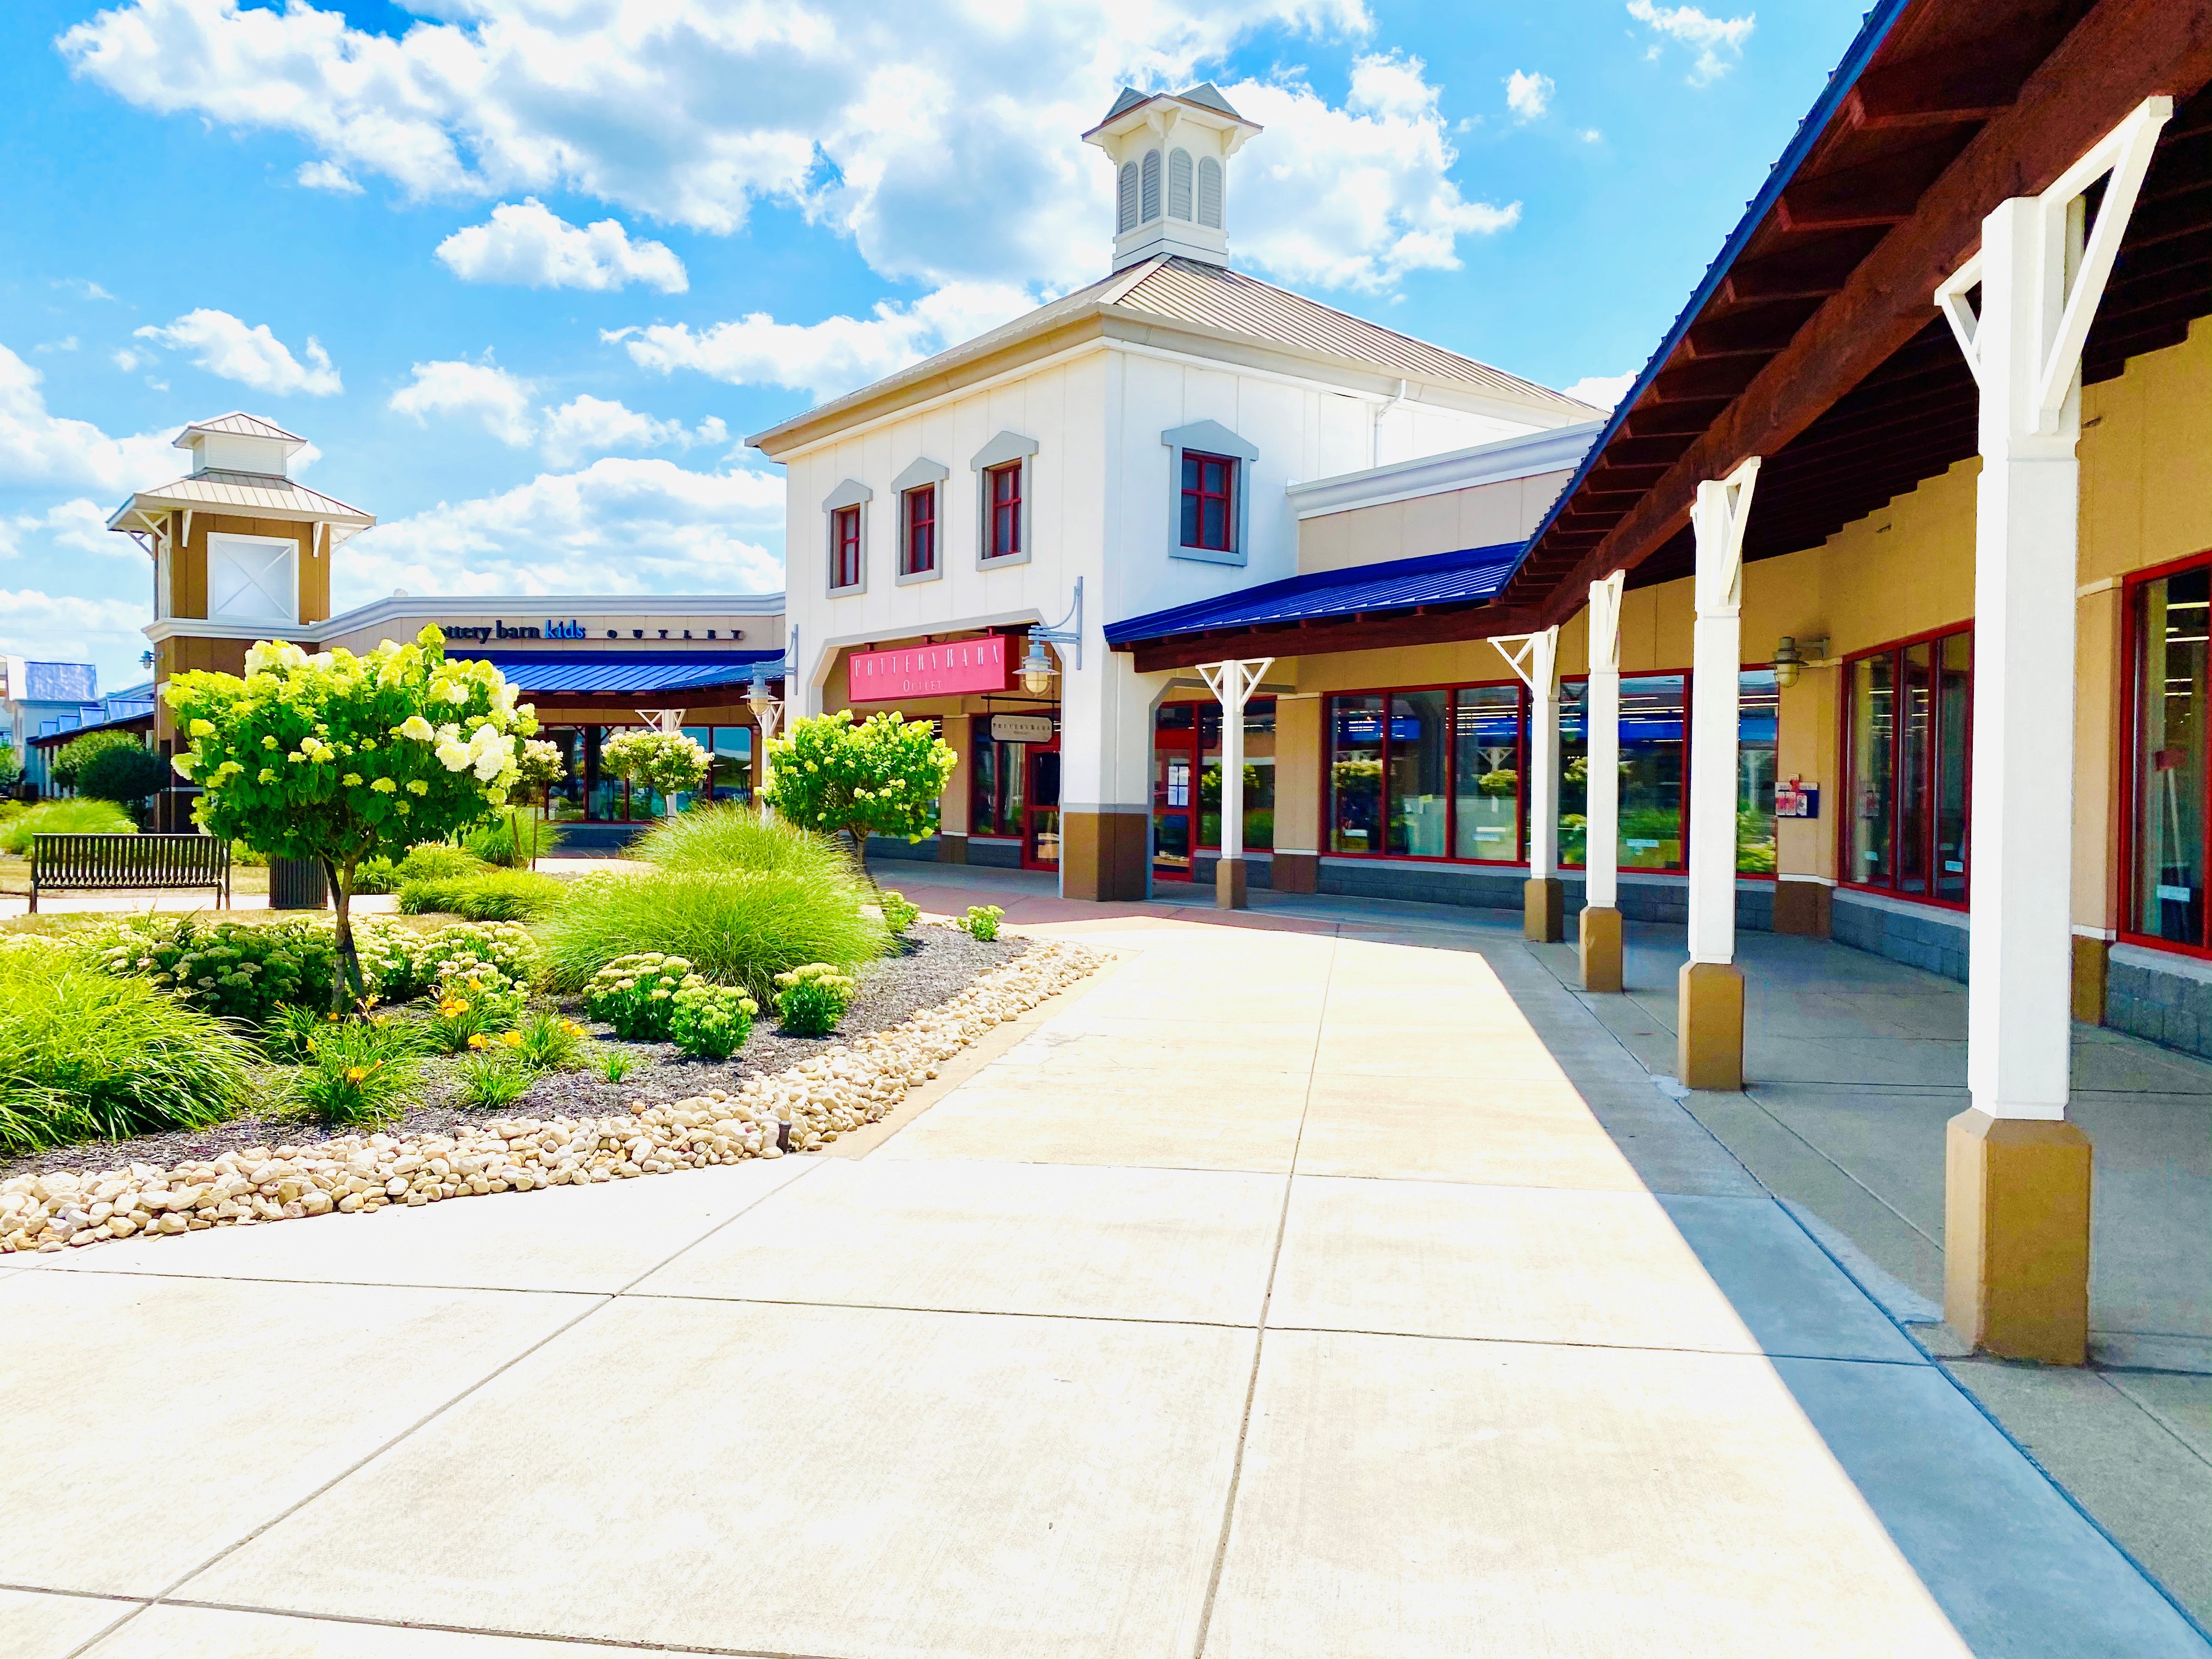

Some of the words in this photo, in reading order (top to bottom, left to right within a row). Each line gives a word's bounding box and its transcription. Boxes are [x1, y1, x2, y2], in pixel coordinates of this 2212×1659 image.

[438, 626, 493, 644] ttery
[496, 620, 539, 639] barn
[545, 619, 585, 639] kids
[607, 629, 741, 640] OUTLET
